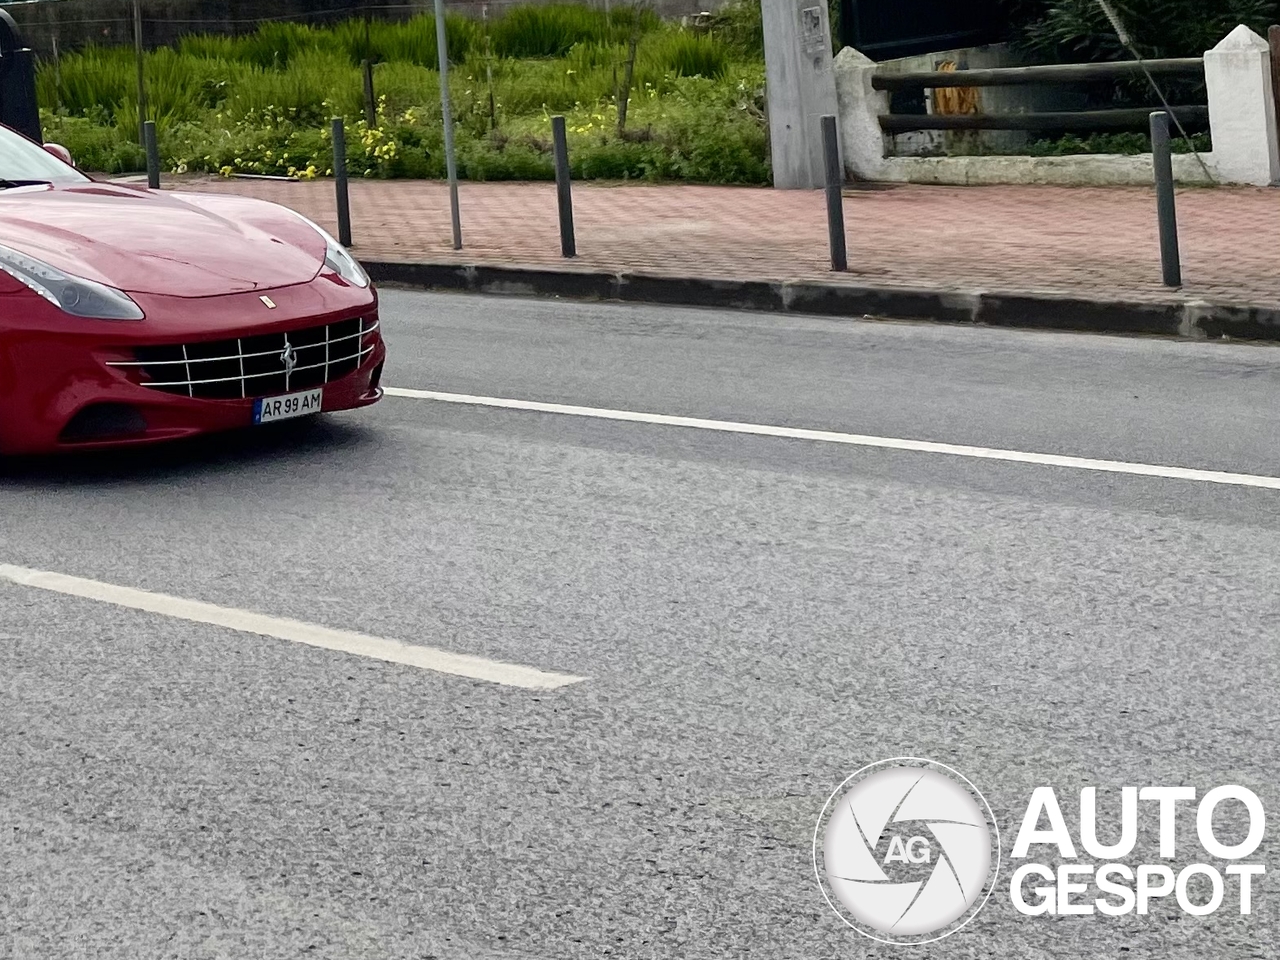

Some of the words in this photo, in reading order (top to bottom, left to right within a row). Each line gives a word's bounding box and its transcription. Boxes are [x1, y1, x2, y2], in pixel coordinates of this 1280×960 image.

[262, 400, 282, 418] AR
[284, 397, 300, 414] 99
[301, 393, 321, 411] AM
